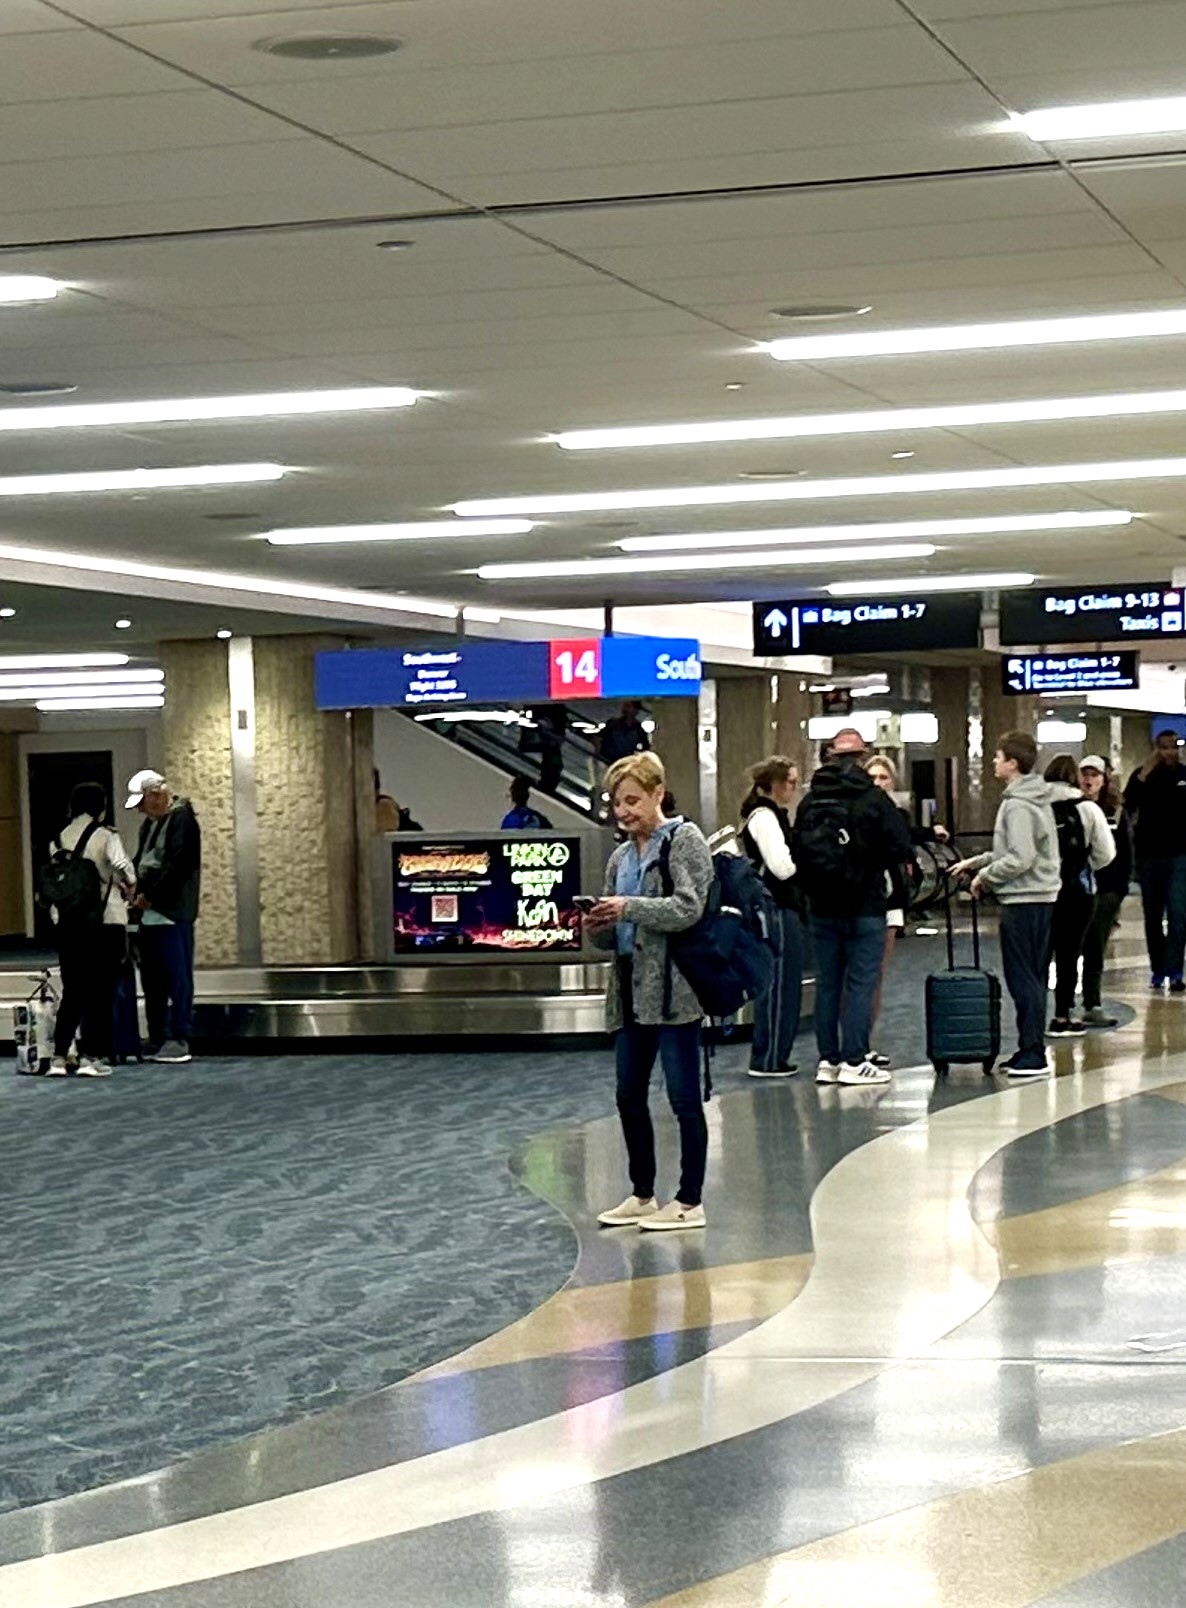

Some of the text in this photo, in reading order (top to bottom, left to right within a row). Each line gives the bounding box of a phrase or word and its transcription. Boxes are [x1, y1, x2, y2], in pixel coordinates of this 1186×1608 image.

[1045, 592, 1160, 614] Bag Claim 9-13
[822, 604, 926, 625] Bag Claim 1-7
[1119, 615, 1160, 631] Taxis
[555, 650, 598, 684] 14
